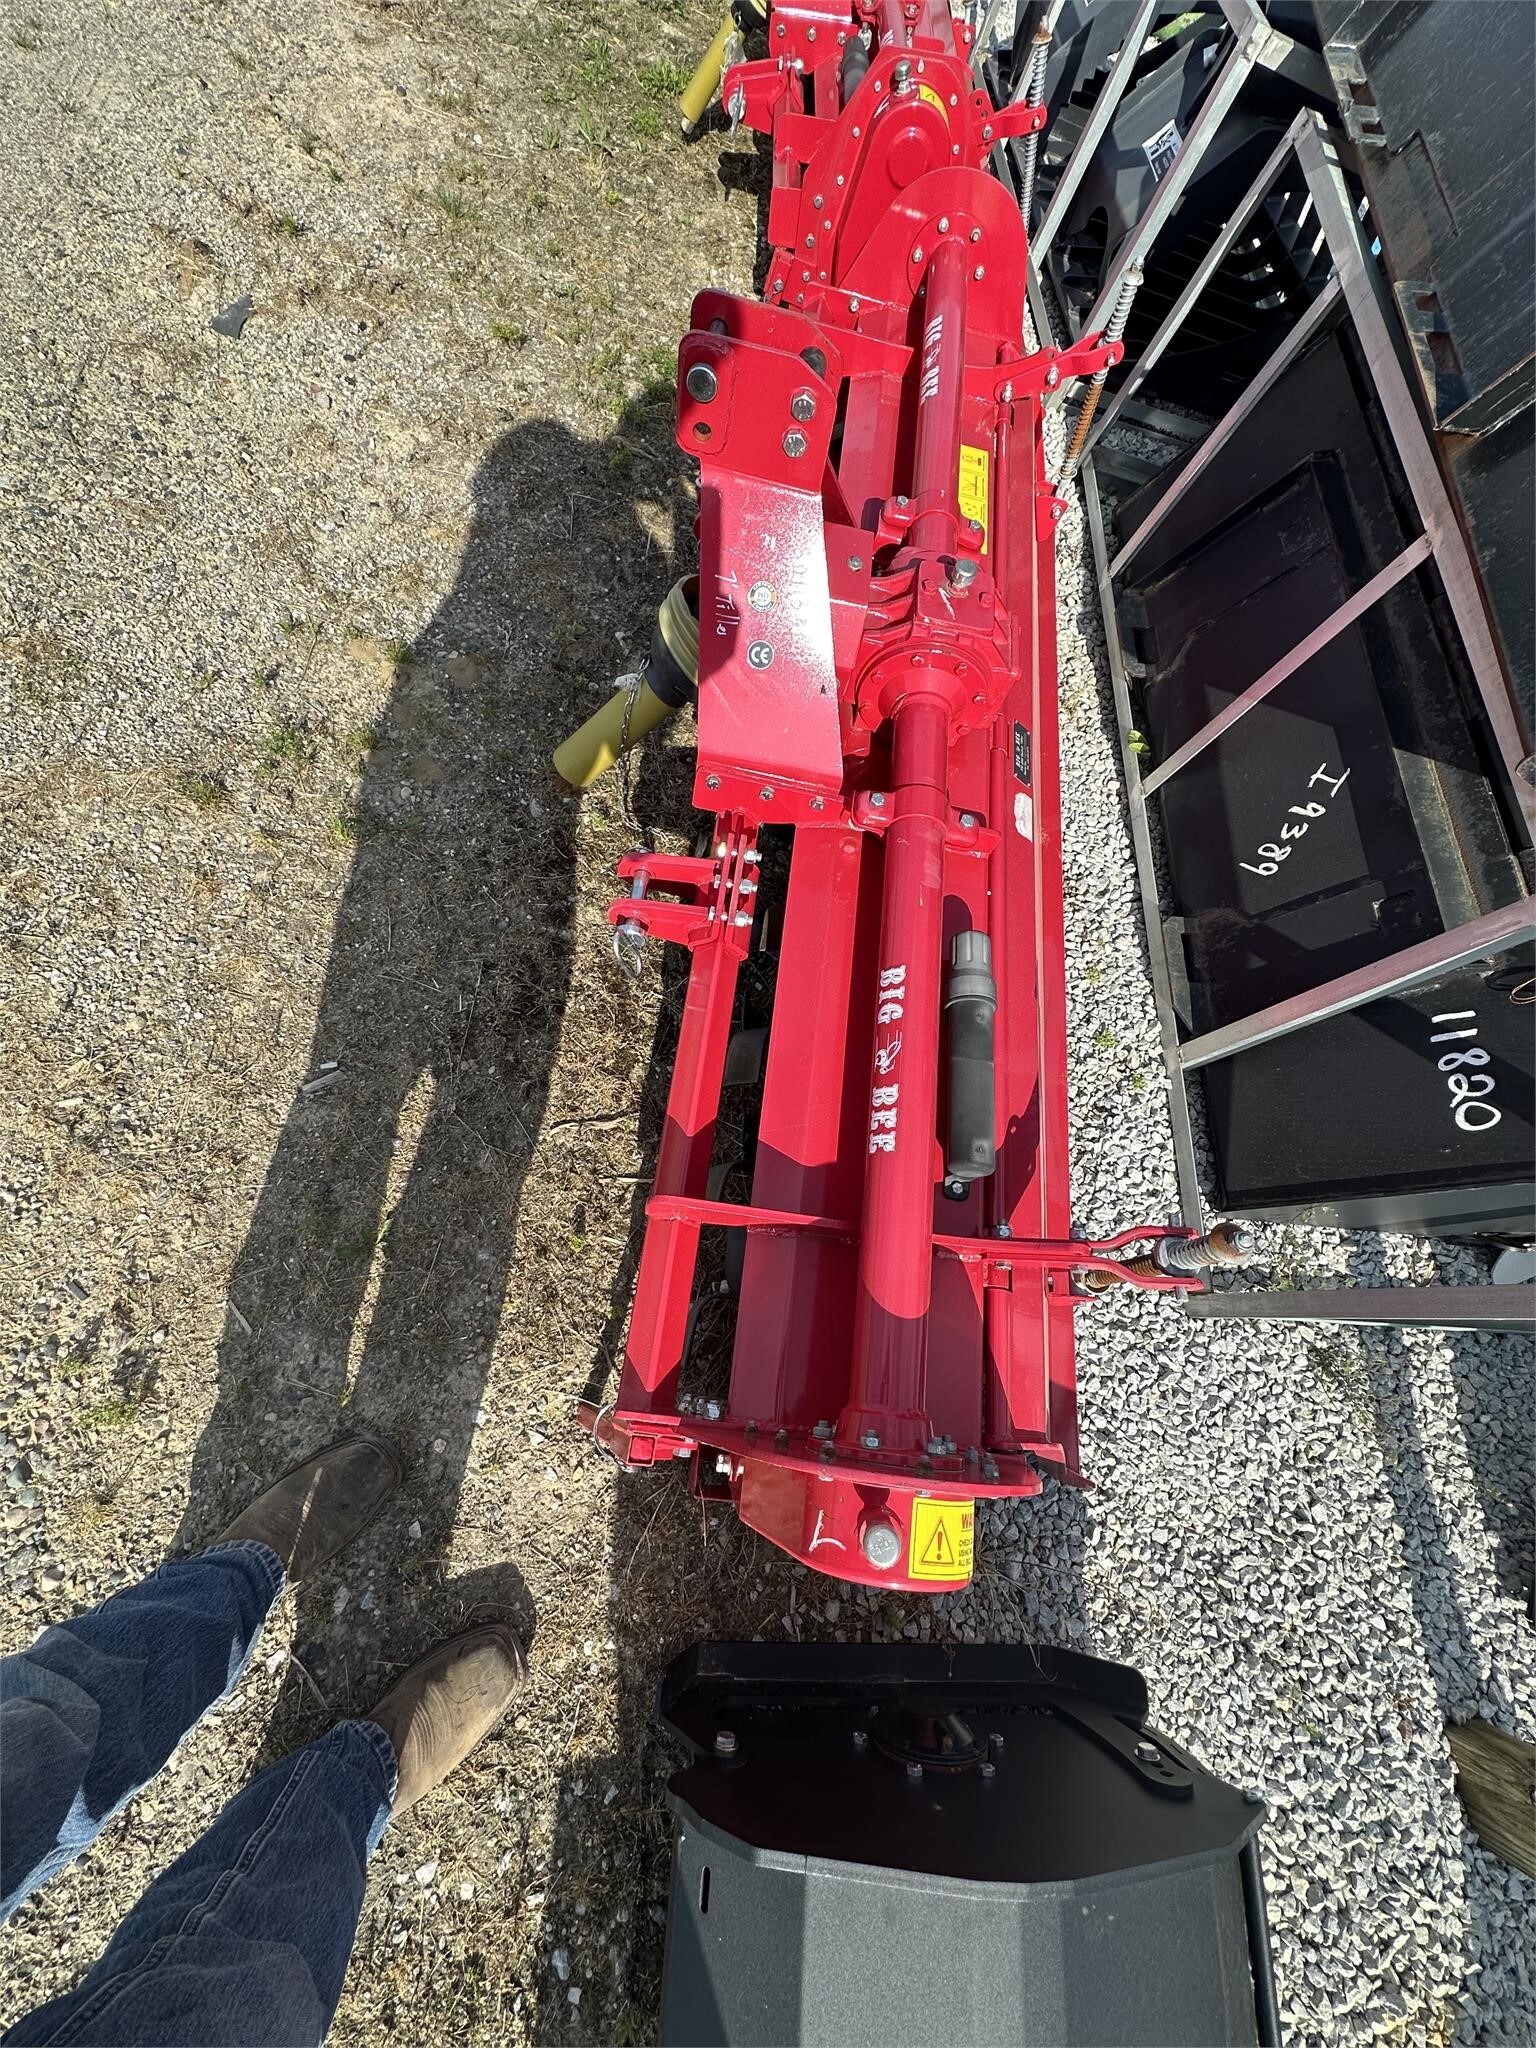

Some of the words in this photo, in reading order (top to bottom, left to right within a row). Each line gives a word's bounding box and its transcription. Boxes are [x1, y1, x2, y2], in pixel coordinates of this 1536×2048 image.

[924, 314, 944, 350] BIG
[750, 646, 769, 664] CE
[877, 964, 907, 1025] BIG
[1430, 1010, 1502, 1131] 11820
[869, 1083, 899, 1154] BEE
